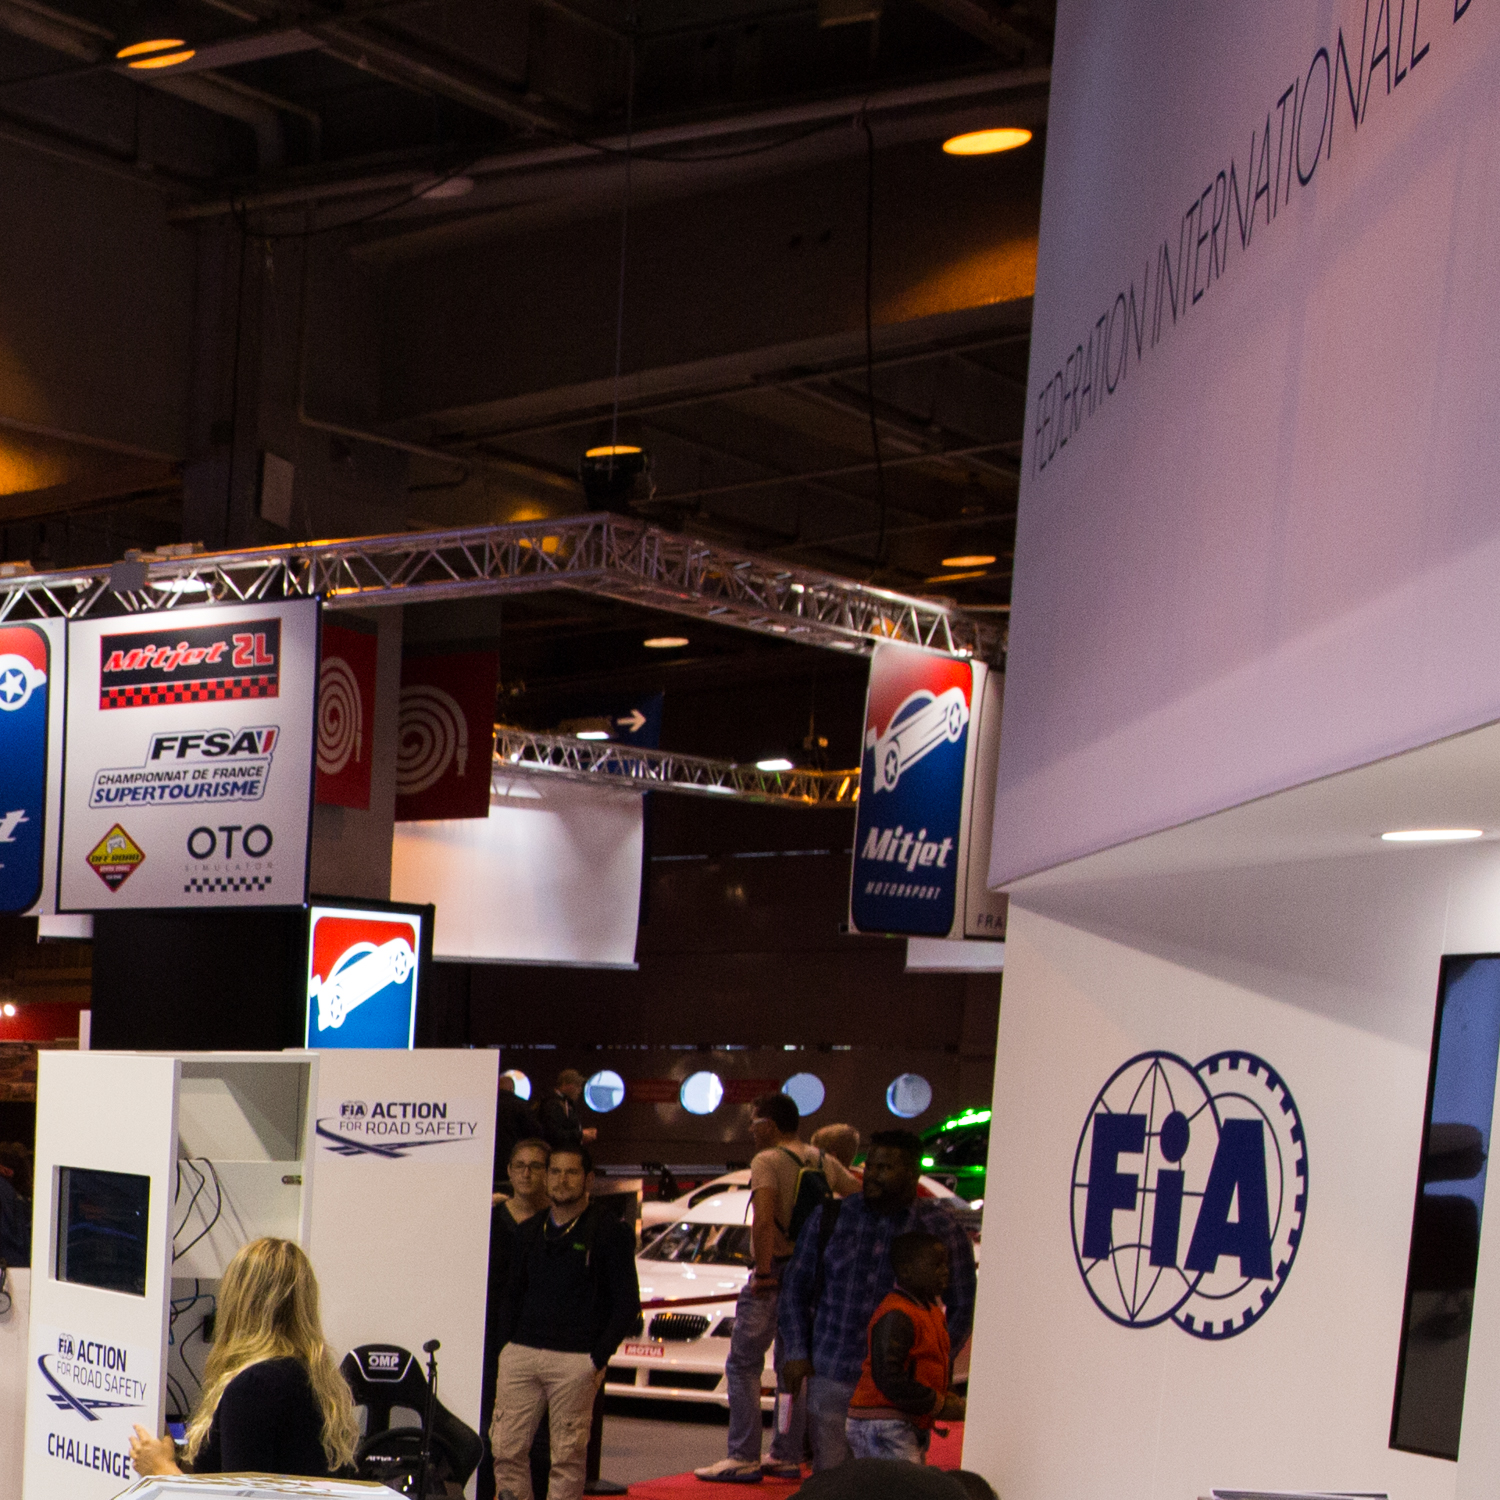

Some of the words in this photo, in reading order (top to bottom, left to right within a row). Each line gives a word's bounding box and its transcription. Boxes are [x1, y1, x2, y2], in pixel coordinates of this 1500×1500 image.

[1031, 259, 1149, 482] FEDERATION
[102, 641, 230, 672] Mitjet
[231, 632, 274, 669] 2L
[151, 730, 260, 760] FFSA
[97, 769, 189, 786] CHAMPIONNAT
[192, 768, 209, 780] DE
[212, 765, 264, 779] FRANCE
[94, 779, 261, 804] SUPERTOURISME
[186, 824, 274, 860] OTO
[861, 825, 954, 873] Mitjet
[183, 863, 274, 872] SIMULATOR
[864, 881, 942, 900] MOTORSPORT
[371, 1102, 447, 1119] ACTION
[339, 1121, 362, 1132] FOR
[365, 1121, 411, 1136] ROAD
[414, 1121, 478, 1136] SAFETY
[77, 1339, 128, 1373] ACTION
[368, 1354, 400, 1368] OMP
[56, 1360, 72, 1377] FOR
[73, 1364, 102, 1390] ROAD
[104, 1373, 147, 1401] SAFETY
[47, 1432, 132, 1481] CHALLENGE
